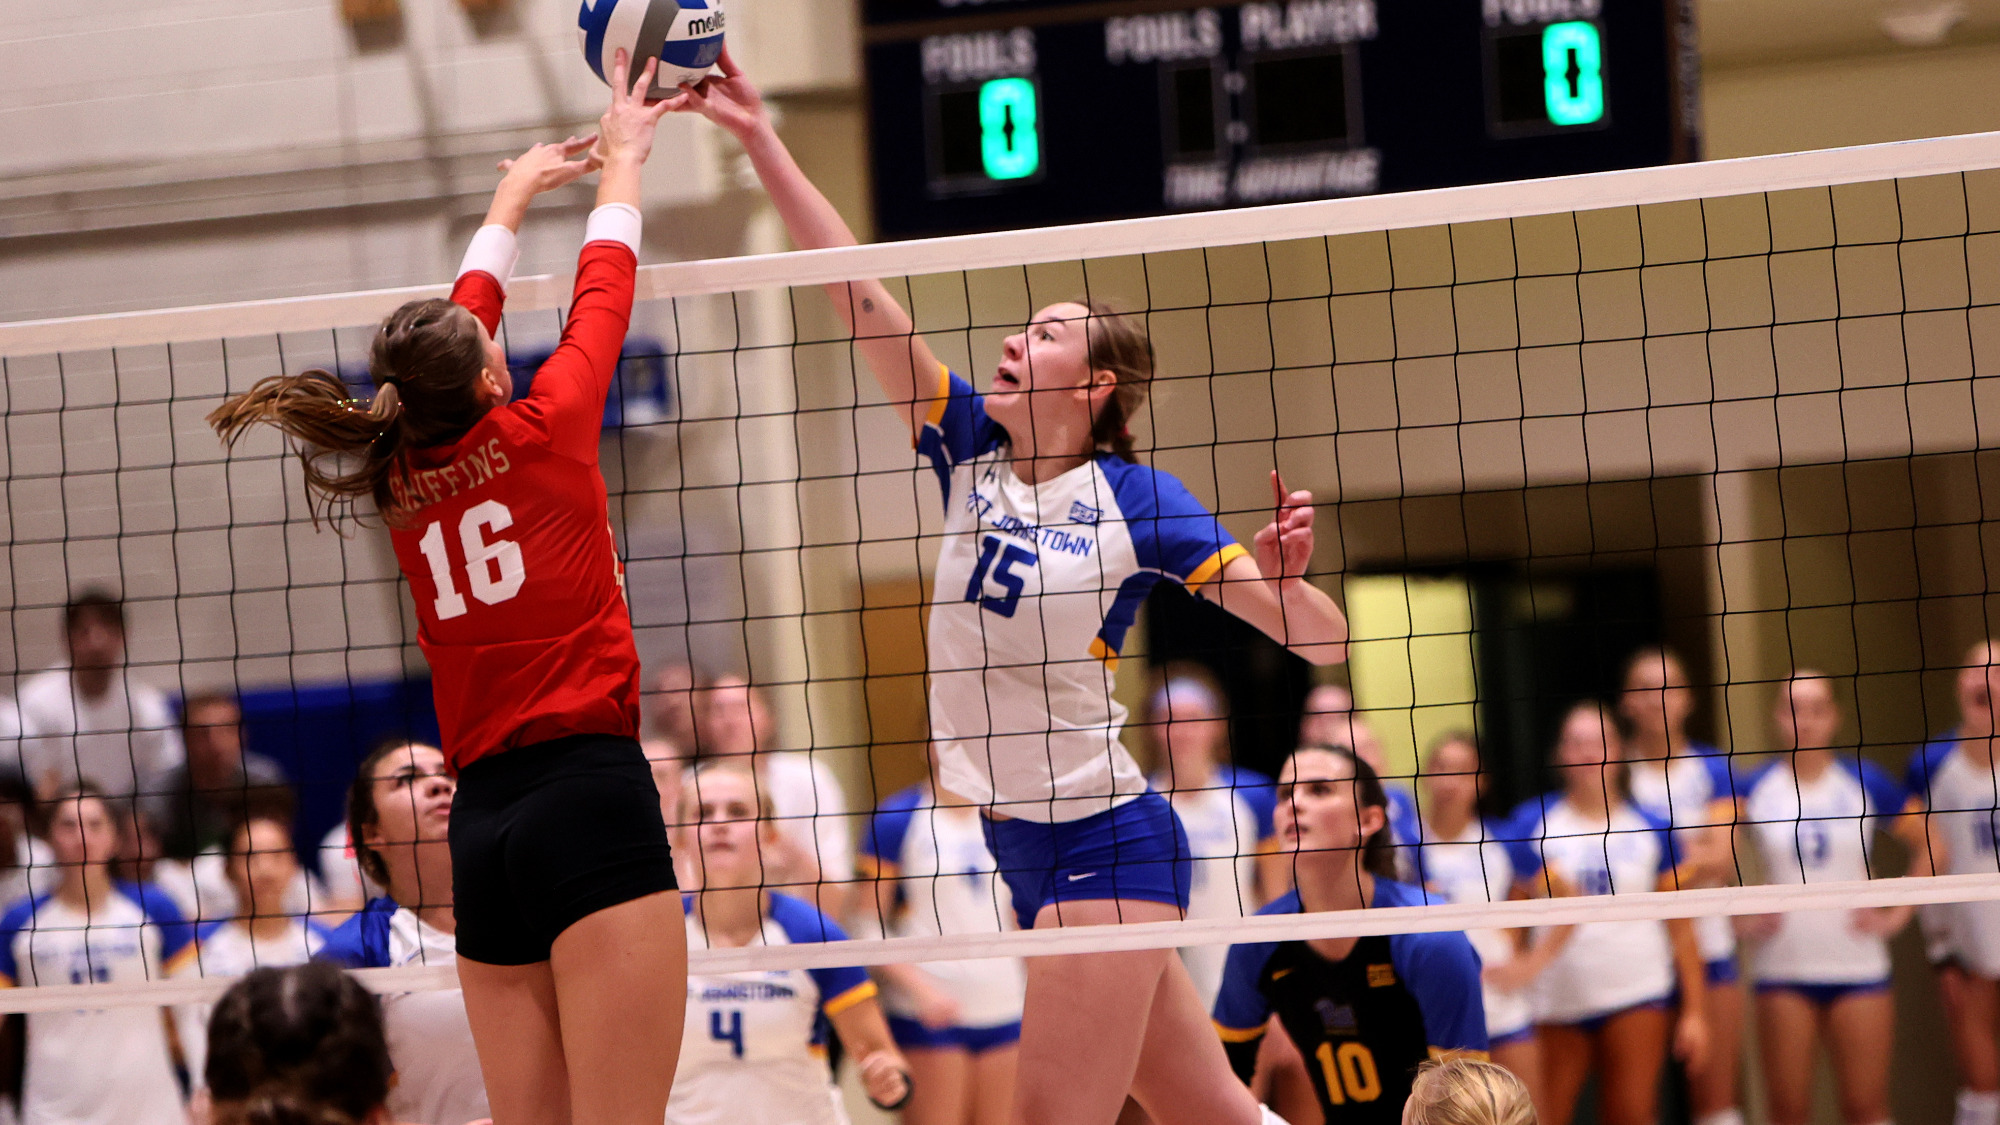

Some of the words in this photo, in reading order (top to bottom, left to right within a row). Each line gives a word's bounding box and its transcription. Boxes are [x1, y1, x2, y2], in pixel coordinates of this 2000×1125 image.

[921, 28, 1037, 83] FOULS
[1105, 8, 1221, 64] FOULS
[1239, 0, 1378, 50] PLAYER
[1542, 20, 1604, 126] 0
[979, 78, 1039, 180] 0
[419, 499, 526, 620] 16
[964, 536, 1038, 618] 15
[710, 1010, 743, 1058] 4
[1315, 1041, 1382, 1105] 10
